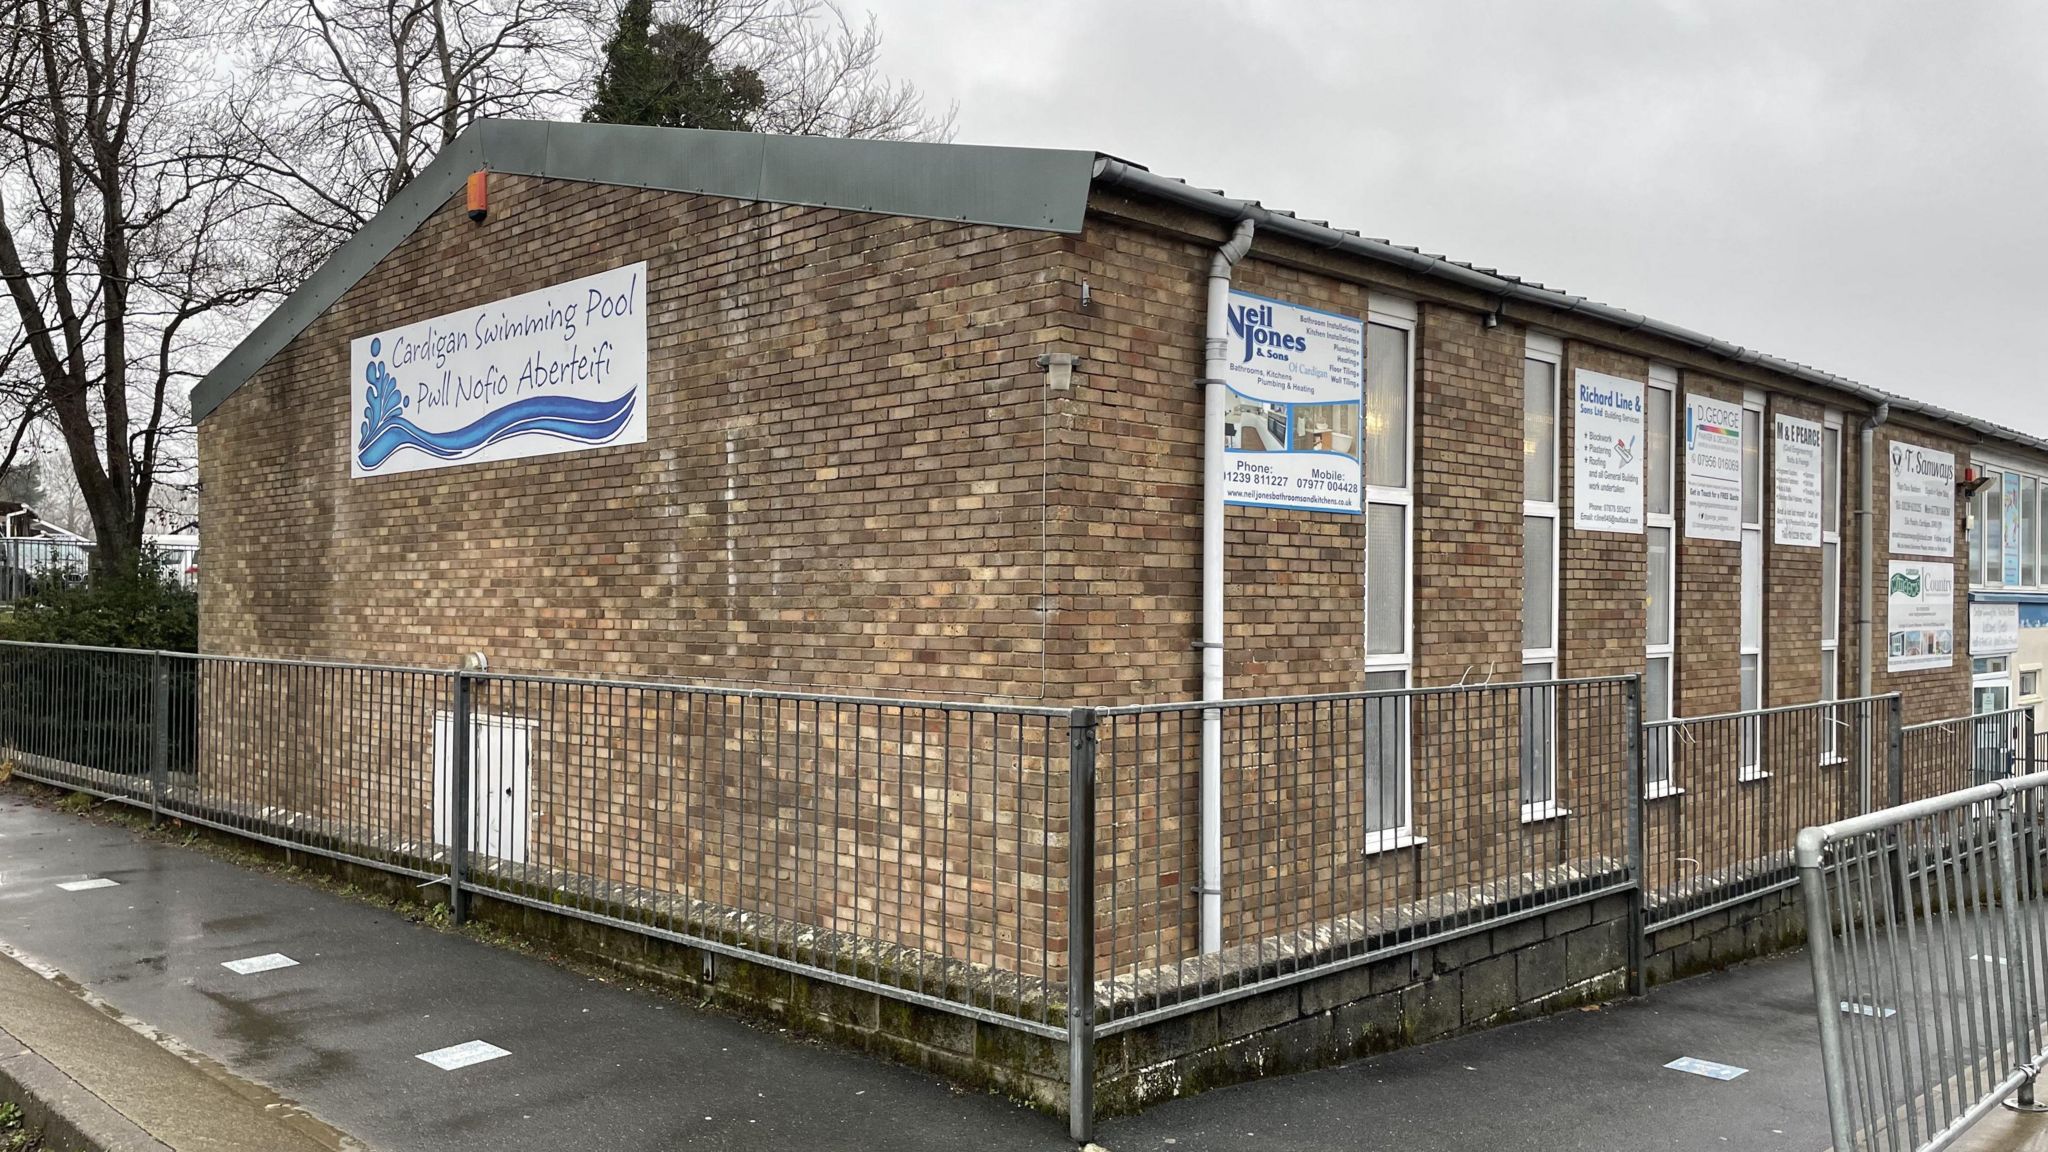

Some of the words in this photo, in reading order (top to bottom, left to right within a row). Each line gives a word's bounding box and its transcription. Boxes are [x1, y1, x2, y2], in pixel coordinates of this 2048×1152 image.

[392, 327, 468, 369] Cardigan
[475, 300, 577, 350] Swimming
[586, 273, 637, 326] Pool
[1227, 302, 1273, 339] Neil
[1300, 315, 1325, 326] Bathroom
[1327, 321, 1356, 334] Installations
[1306, 328, 1325, 338] Kitchen
[1244, 324, 1306, 363] Jones
[1257, 347, 1265, 357] &
[1267, 349, 1289, 361] Sons
[417, 370, 451, 414] Pwll
[455, 365, 508, 407] Nofio
[517, 341, 613, 395] Aberteifi
[1229, 363, 1265, 376] Bathrooms,
[1266, 369, 1292, 380] Kitchens
[1299, 363, 1328, 378] Cardigan
[1257, 377, 1285, 390] Plumbing
[1292, 384, 1315, 395] Heating
[1580, 384, 1613, 407] Richard
[1615, 391, 1633, 411] Line
[1635, 395, 1641, 412] &
[1580, 403, 1593, 414] Sons
[1594, 406, 1603, 417] Ltd
[1777, 421, 1783, 439] M
[1785, 425, 1789, 441] &
[1791, 425, 1795, 442] E
[1796, 426, 1820, 447] PEARCE
[1237, 460, 1273, 474] Phone:
[1311, 468, 1345, 481] Mobile:
[1905, 448, 1913, 473] T.
[1916, 451, 1953, 486] Samways
[1254, 474, 1288, 486] 811227
[1296, 478, 1324, 490] 07977
[1327, 481, 1358, 493] 004428
